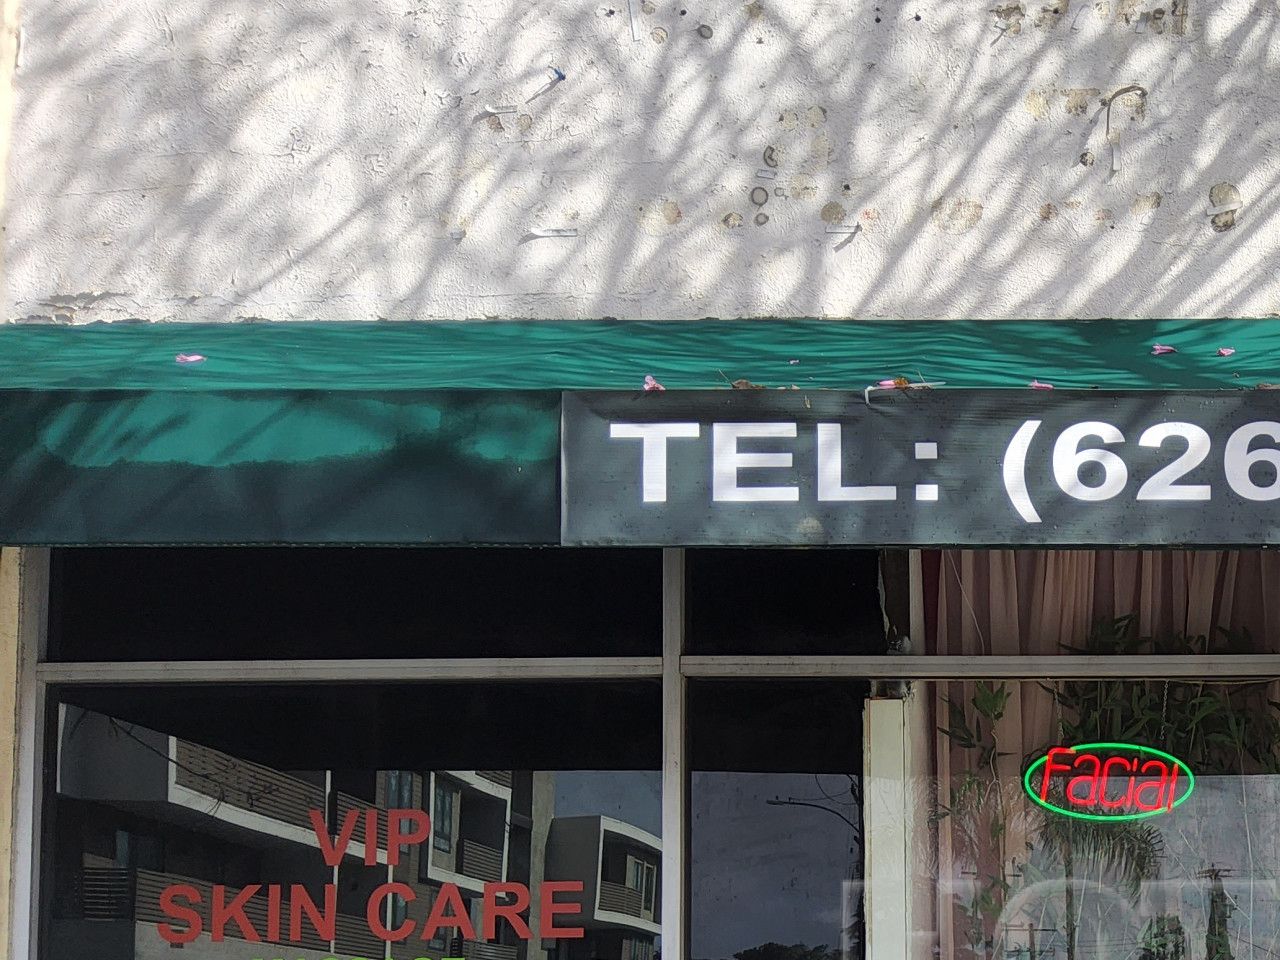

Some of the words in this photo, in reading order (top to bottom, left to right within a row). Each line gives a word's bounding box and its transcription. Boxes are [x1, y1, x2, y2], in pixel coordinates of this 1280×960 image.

[610, 422, 938, 503] TEL:
[1041, 747, 1179, 813] Facial
[309, 808, 431, 867] VIP
[157, 884, 336, 944] SKIN
[367, 881, 584, 942] CARE
